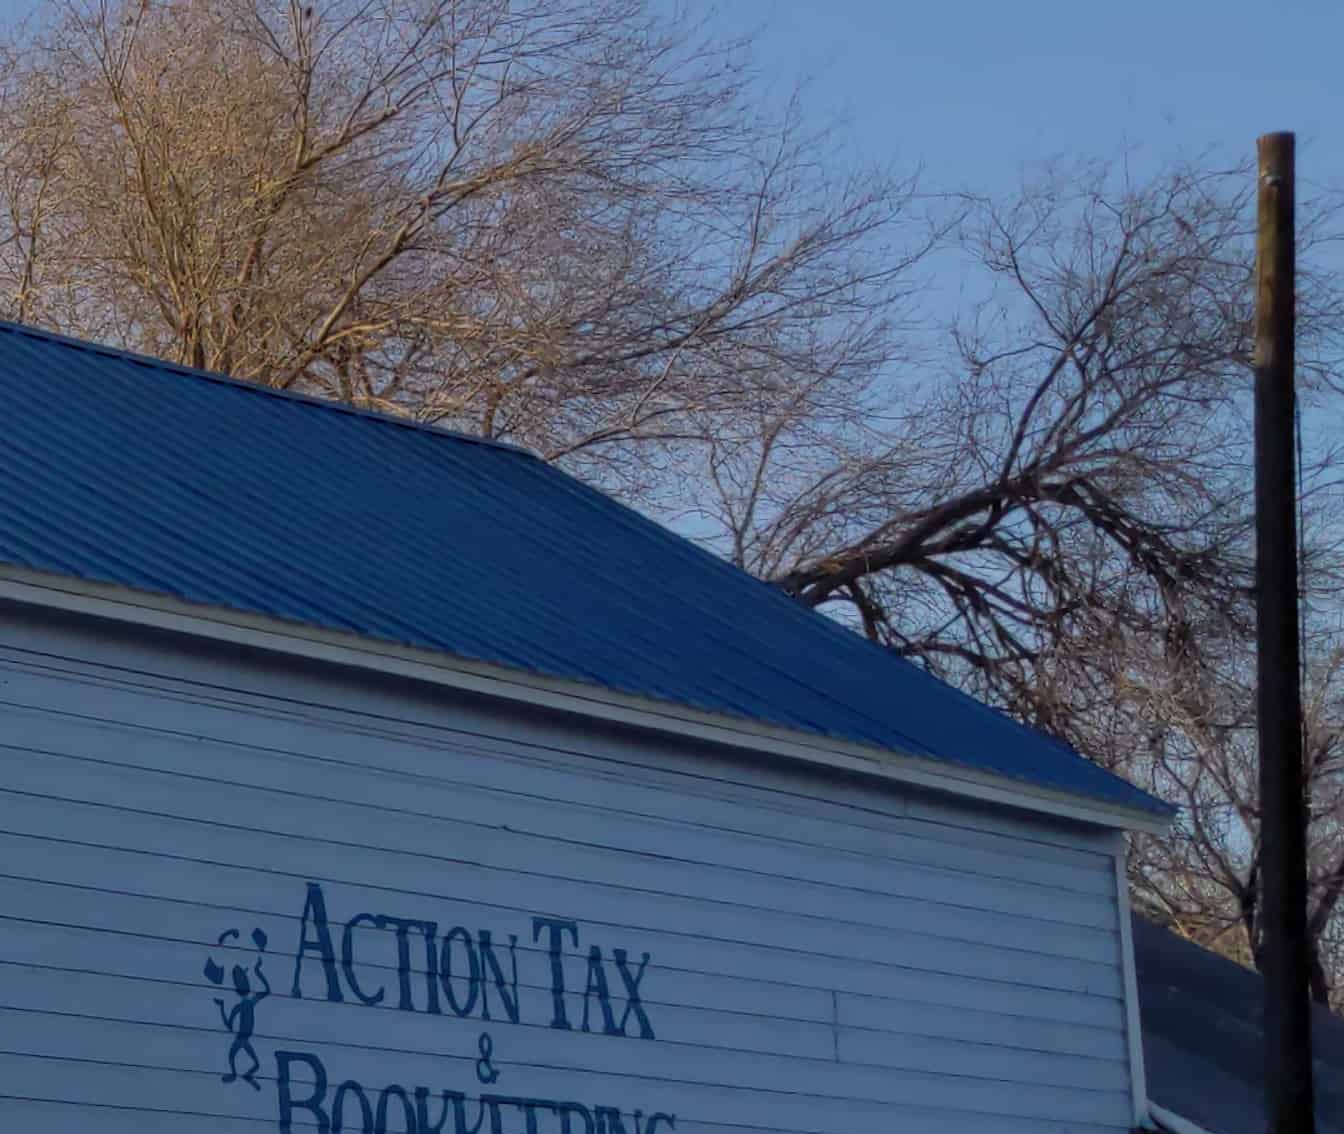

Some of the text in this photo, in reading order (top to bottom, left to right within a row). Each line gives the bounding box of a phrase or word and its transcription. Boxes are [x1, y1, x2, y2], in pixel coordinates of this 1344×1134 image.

[291, 881, 656, 1040] ACTION TAX
[476, 1032, 500, 1084] &
